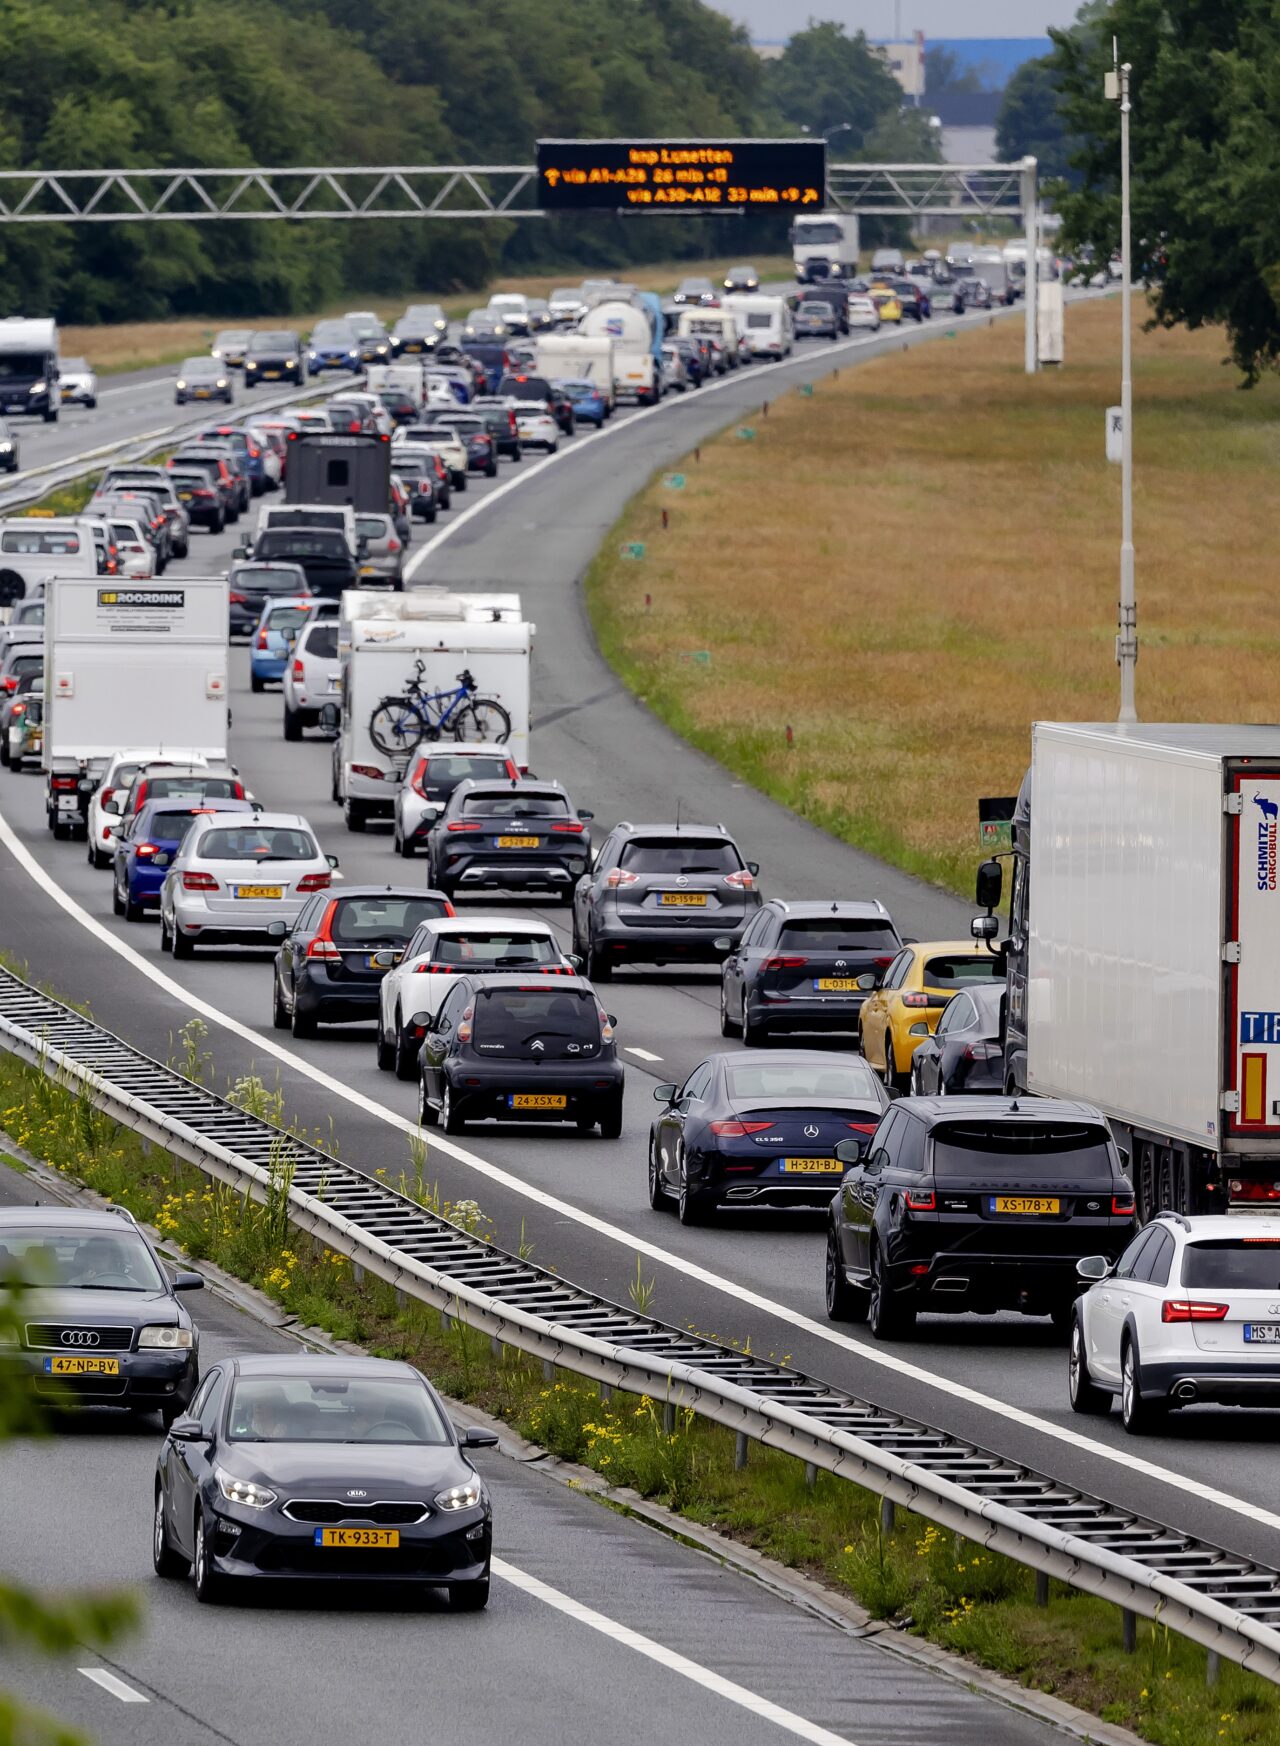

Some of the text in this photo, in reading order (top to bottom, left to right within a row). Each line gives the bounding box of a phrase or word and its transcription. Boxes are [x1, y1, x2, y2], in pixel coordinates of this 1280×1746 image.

[117, 592, 183, 604] ROORDINK
[1257, 822, 1269, 890] SCHMITZ
[1268, 822, 1277, 890] CARGOBULL
[823, 980, 857, 989] L-031-F
[517, 1096, 563, 1106] 24-XSX-4
[791, 1160, 837, 1170] H-321-BJ
[1002, 1199, 1053, 1212] XS-178-X
[1251, 1326, 1266, 1339] MS
[56, 1359, 115, 1372] 47-NP-BV
[329, 1531, 392, 1545] TK-933-T
